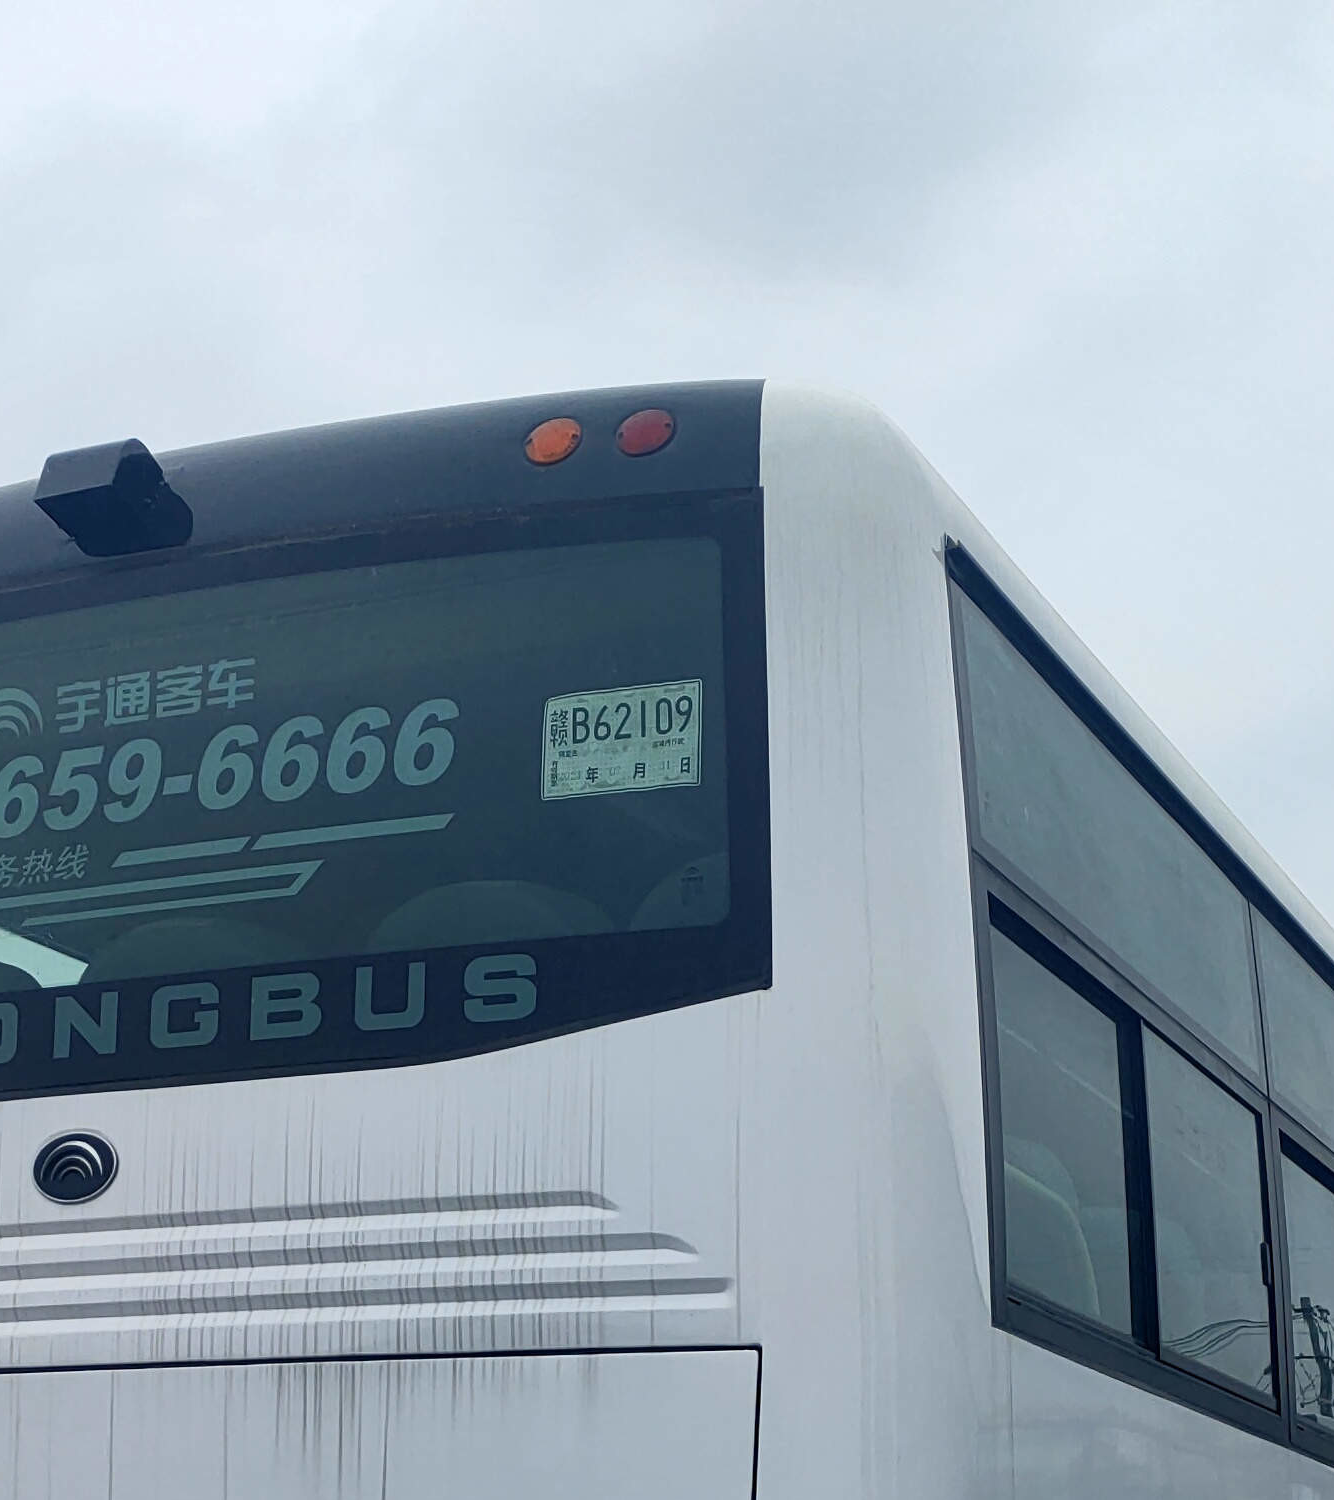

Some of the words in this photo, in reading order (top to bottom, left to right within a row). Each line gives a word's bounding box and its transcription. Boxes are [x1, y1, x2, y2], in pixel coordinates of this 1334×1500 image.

[55, 657, 256, 735] 宇通客车
[549, 695, 693, 748] 赣B62109
